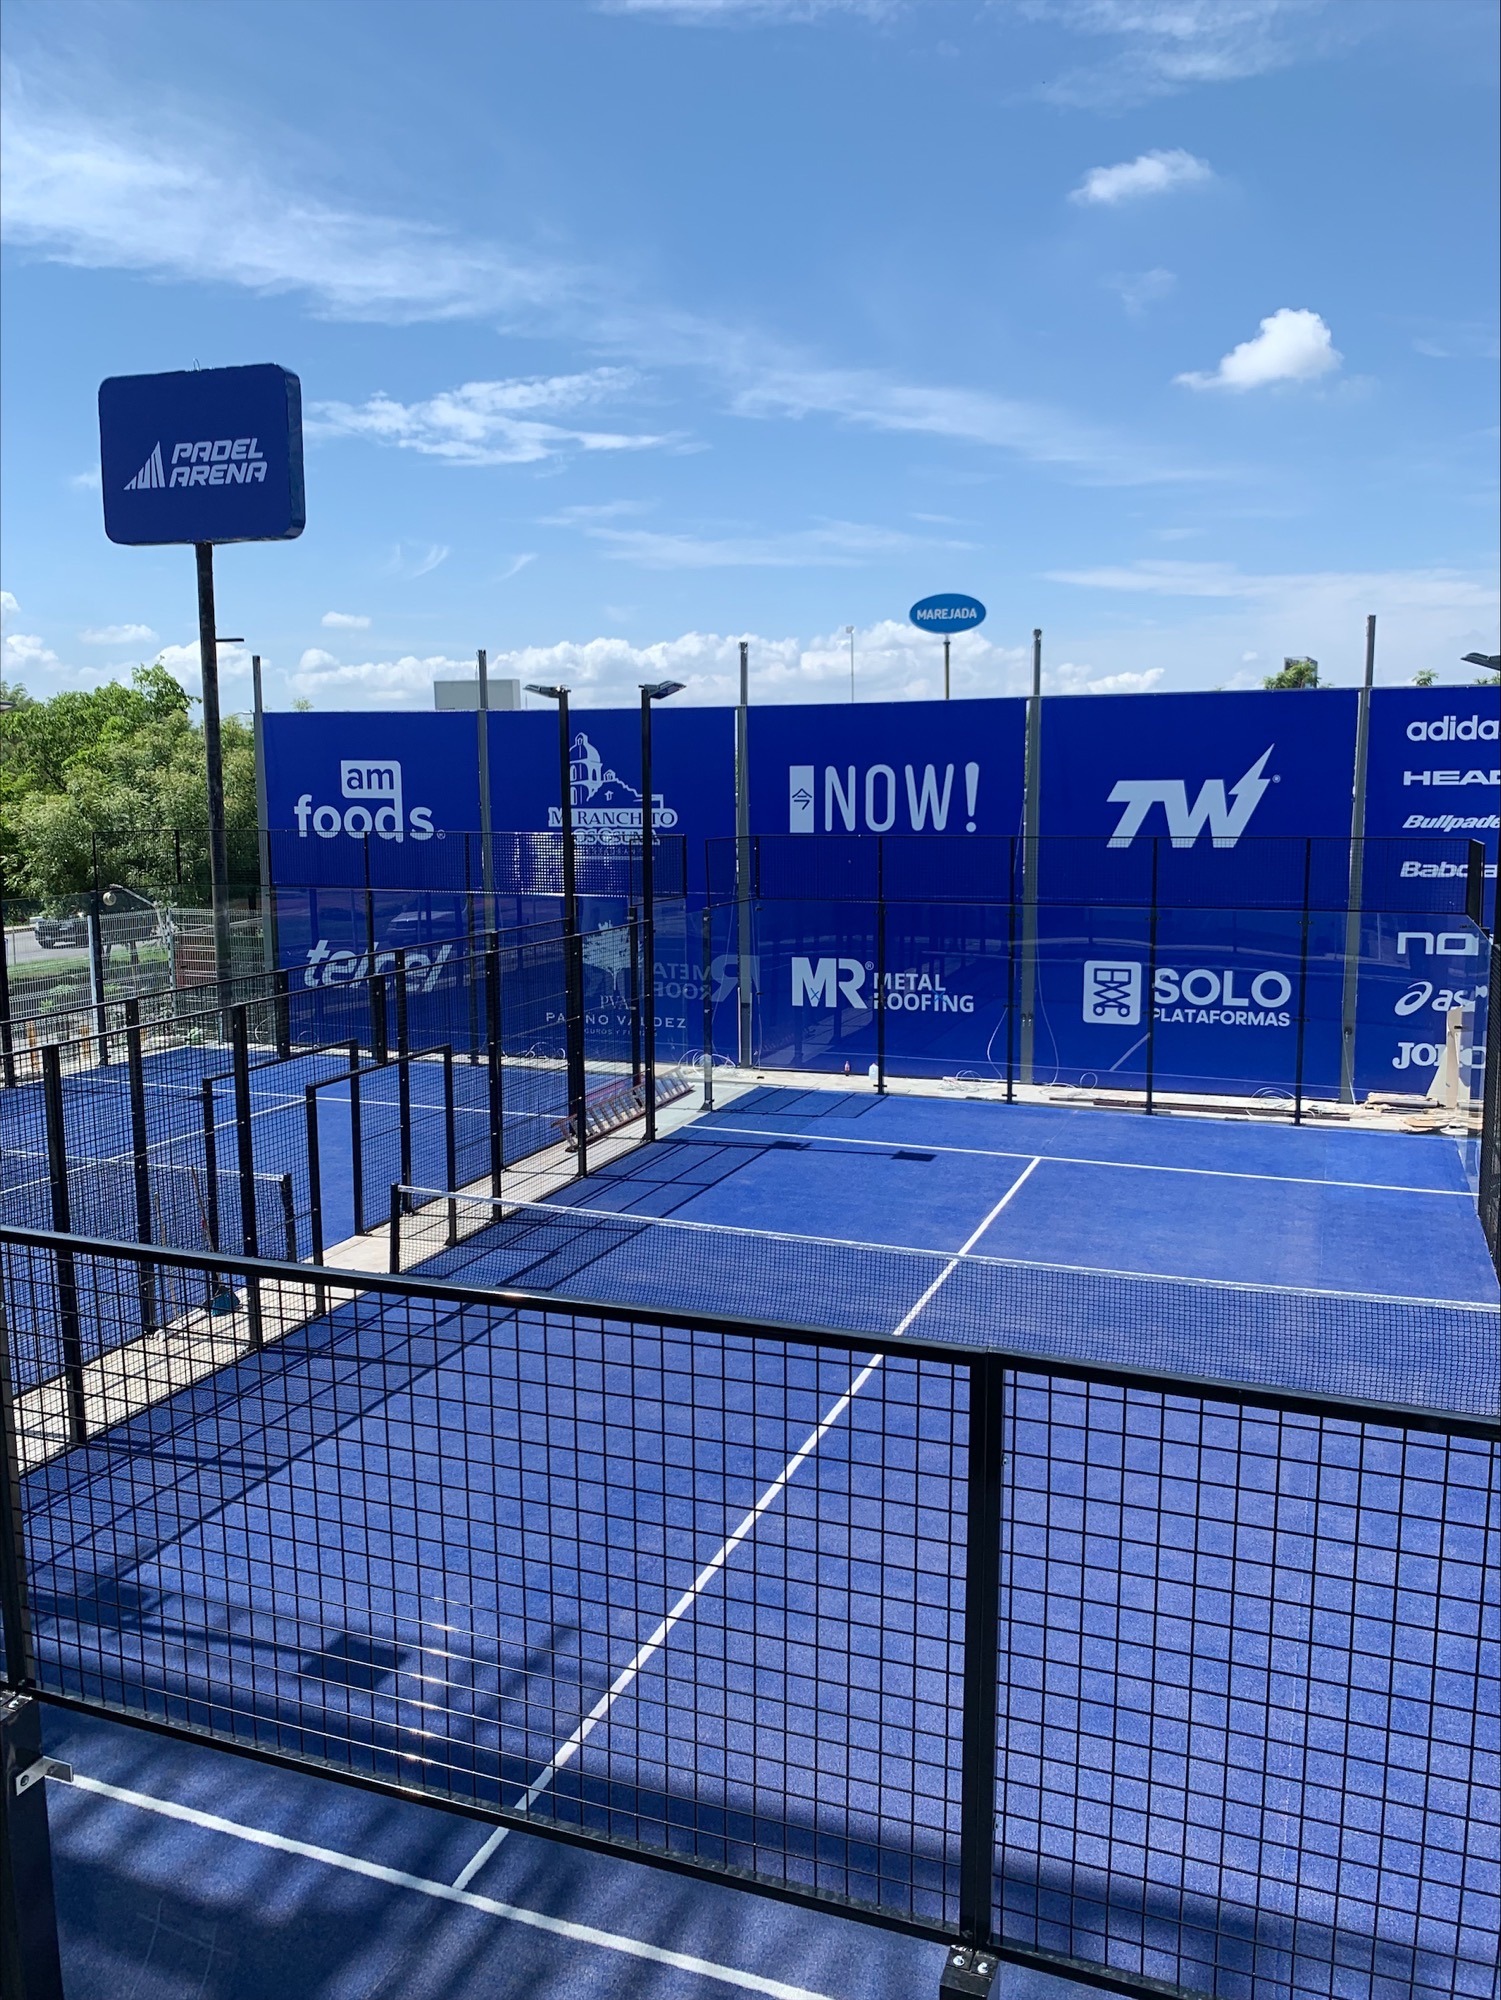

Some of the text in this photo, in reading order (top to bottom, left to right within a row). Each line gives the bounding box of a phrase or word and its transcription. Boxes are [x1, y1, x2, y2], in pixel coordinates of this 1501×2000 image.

[171, 437, 264, 464] PADEL
[169, 461, 268, 488] ARENA
[916, 607, 977, 620] MAREJADA
[1406, 715, 1501, 741] adida
[346, 768, 395, 790] am
[824, 762, 980, 832] NOW!
[294, 794, 435, 843] foods
[577, 811, 675, 826] RANCHTO
[1402, 815, 1501, 832] Bullpade
[873, 972, 946, 991] METAL
[1154, 968, 1292, 1008] SOLO
